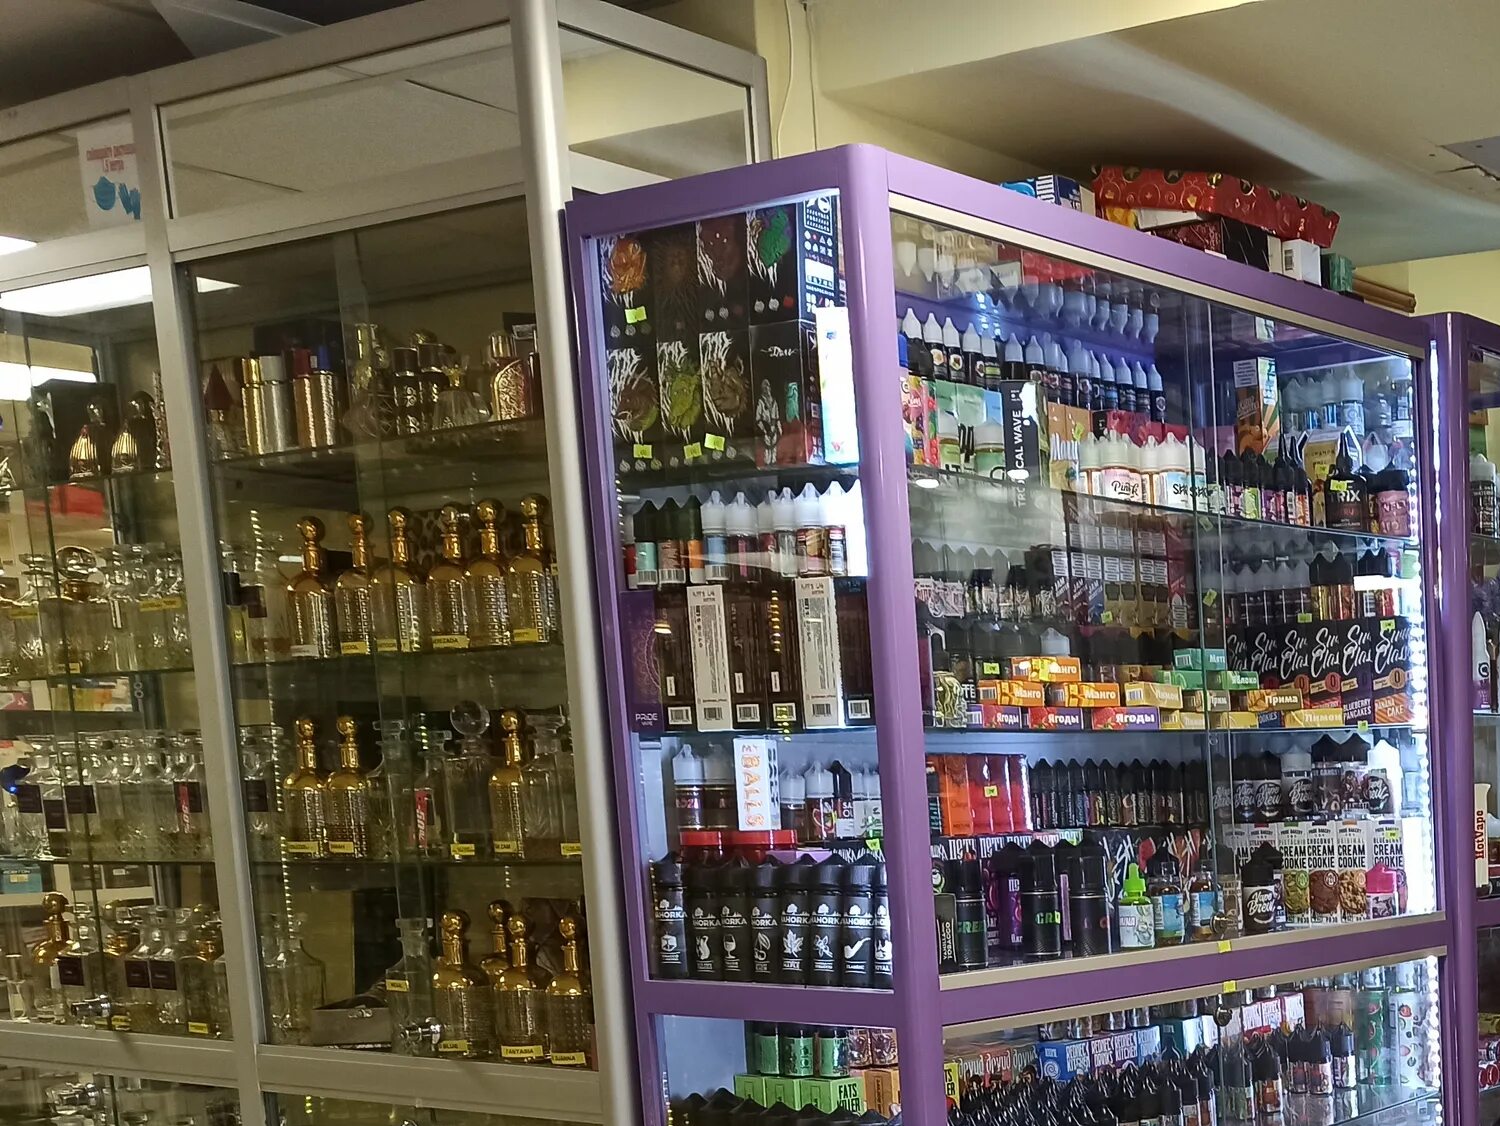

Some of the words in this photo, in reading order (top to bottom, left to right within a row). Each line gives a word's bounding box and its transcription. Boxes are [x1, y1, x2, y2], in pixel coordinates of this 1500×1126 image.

[1012, 410, 1024, 444] WAVE
[1015, 687, 1041, 698] Манго
[1084, 688, 1117, 700] Манго
[1265, 694, 1299, 706] Прима
[1387, 705, 1404, 717] CAKE
[997, 713, 1020, 724] Ягоды
[1048, 712, 1079, 724] Ягоды
[1116, 712, 1155, 724] Ягоды
[1280, 845, 1307, 856] CREAM
[1307, 845, 1335, 856] CREAM
[1338, 845, 1366, 855] CREAM
[1374, 844, 1403, 855] CREAM
[1308, 857, 1335, 868] COOKIE
[1338, 856, 1366, 868] COOKIE
[1251, 888, 1273, 902] Vape
[838, 1084, 858, 1099] FATS
